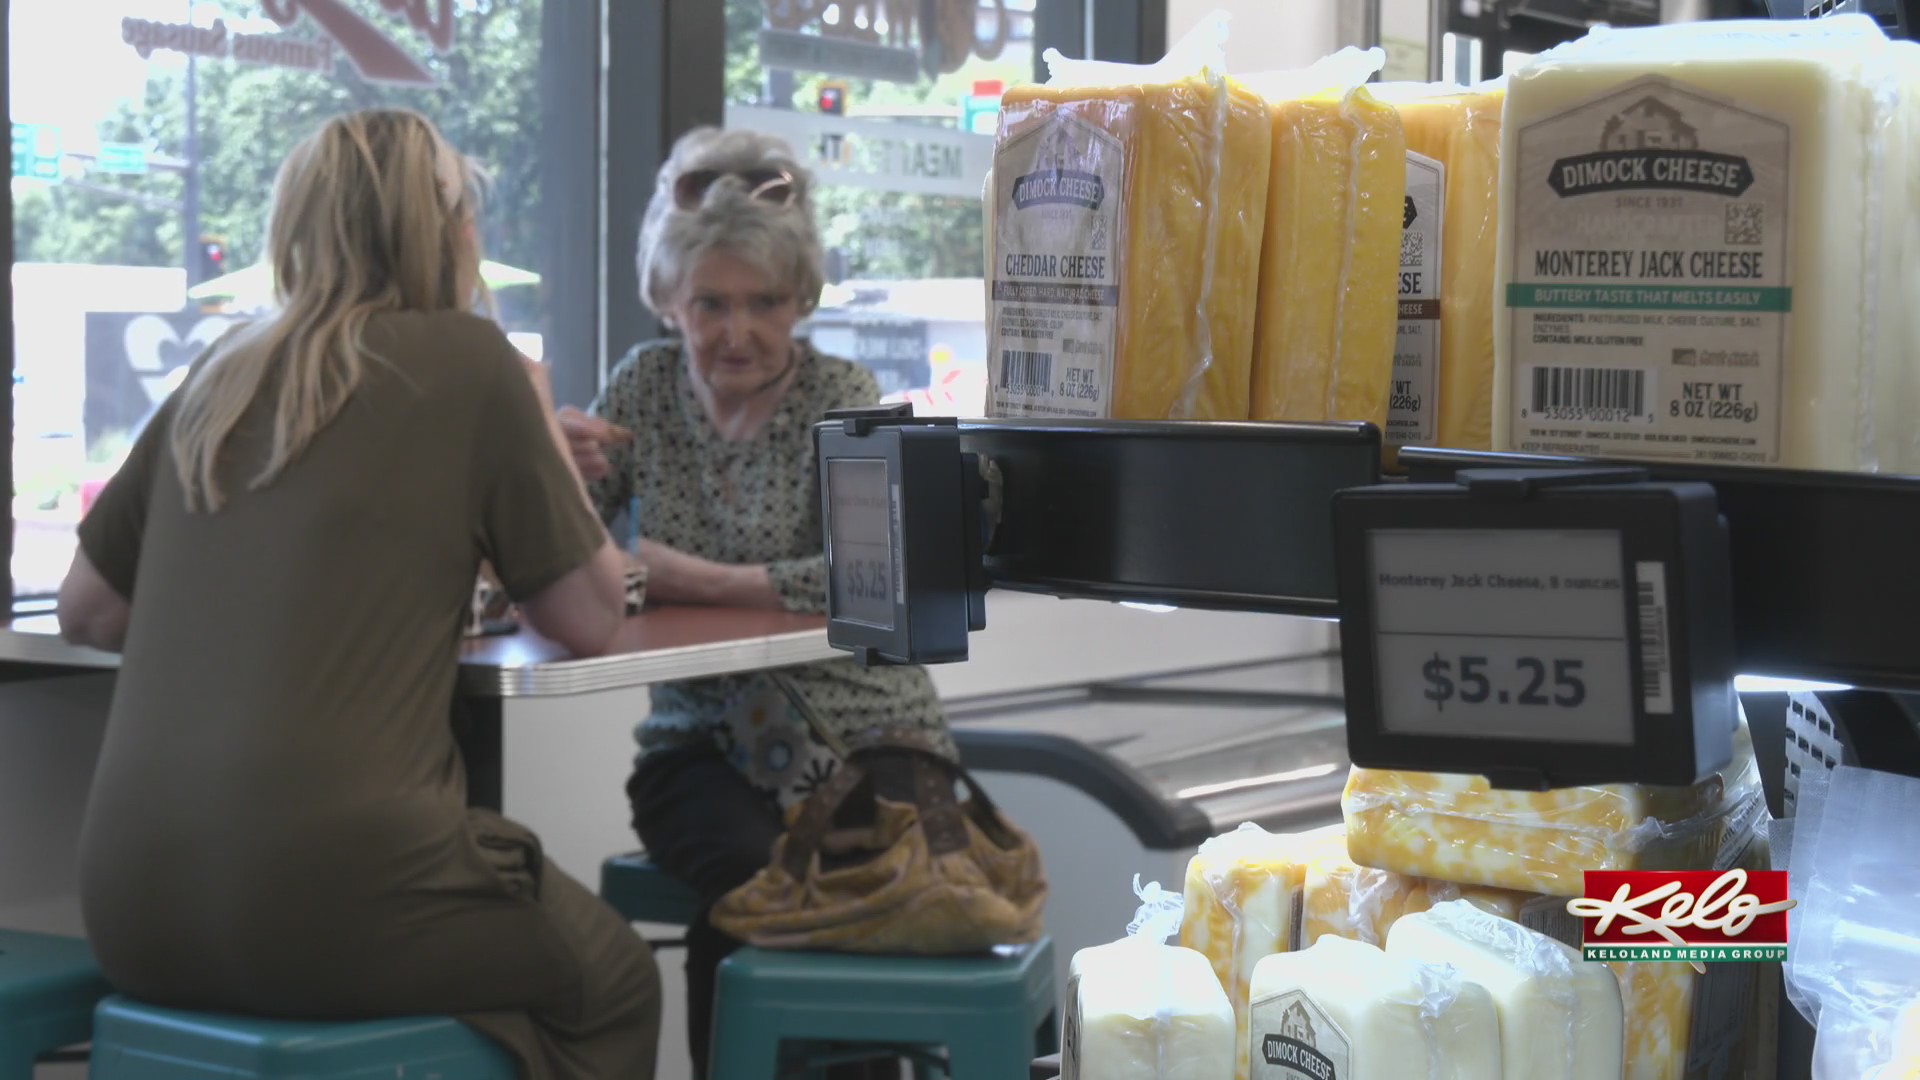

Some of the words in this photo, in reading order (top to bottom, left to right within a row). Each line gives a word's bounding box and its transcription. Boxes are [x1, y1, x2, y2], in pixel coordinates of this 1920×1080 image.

[1562, 157, 1647, 188] DIMOCK
[1652, 157, 1740, 188] CHEESE
[1019, 177, 1056, 202] DIMOCK
[1059, 177, 1099, 203] CHEESE
[1615, 197, 1650, 209] SINCE
[1656, 197, 1683, 209] 1931
[1005, 254, 1056, 277] CHEDDAR
[1060, 255, 1106, 279] CHEESE
[1534, 250, 1634, 278] MONTEREY
[1638, 251, 1684, 278] JACK
[1689, 251, 1763, 279] CHEESE
[1534, 288, 1591, 303] BUTTERY
[1595, 289, 1635, 303] TASTE
[1636, 290, 1671, 303] THAT
[1672, 290, 1713, 304] MELTS
[1715, 291, 1761, 305] EASILY
[1066, 368, 1081, 383] NET
[1082, 369, 1095, 383] WT
[1059, 384, 1065, 395] 8
[1066, 384, 1075, 398] OZ
[1077, 384, 1100, 402] (226g)
[1396, 380, 1411, 394] WT
[1682, 382, 1713, 400] NET
[1717, 383, 1743, 400] WT
[1390, 394, 1421, 412] (226g)
[1670, 401, 1679, 418] 8
[1684, 402, 1704, 418] OZ
[1708, 402, 1758, 422] (226g)
[1521, 409, 1527, 419] 8
[1544, 407, 1583, 421] 53055
[1589, 409, 1630, 422] 00012
[847, 559, 887, 600] $5.25
[1379, 573, 1446, 590] Monterey
[1451, 573, 1483, 589] Jack
[1487, 574, 1545, 591] Cheese,
[1564, 577, 1620, 590] ounces
[1422, 652, 1586, 712] $5.25
[1267, 1040, 1299, 1064] DIMOCK
[1299, 1049, 1332, 1080] CHEESE
